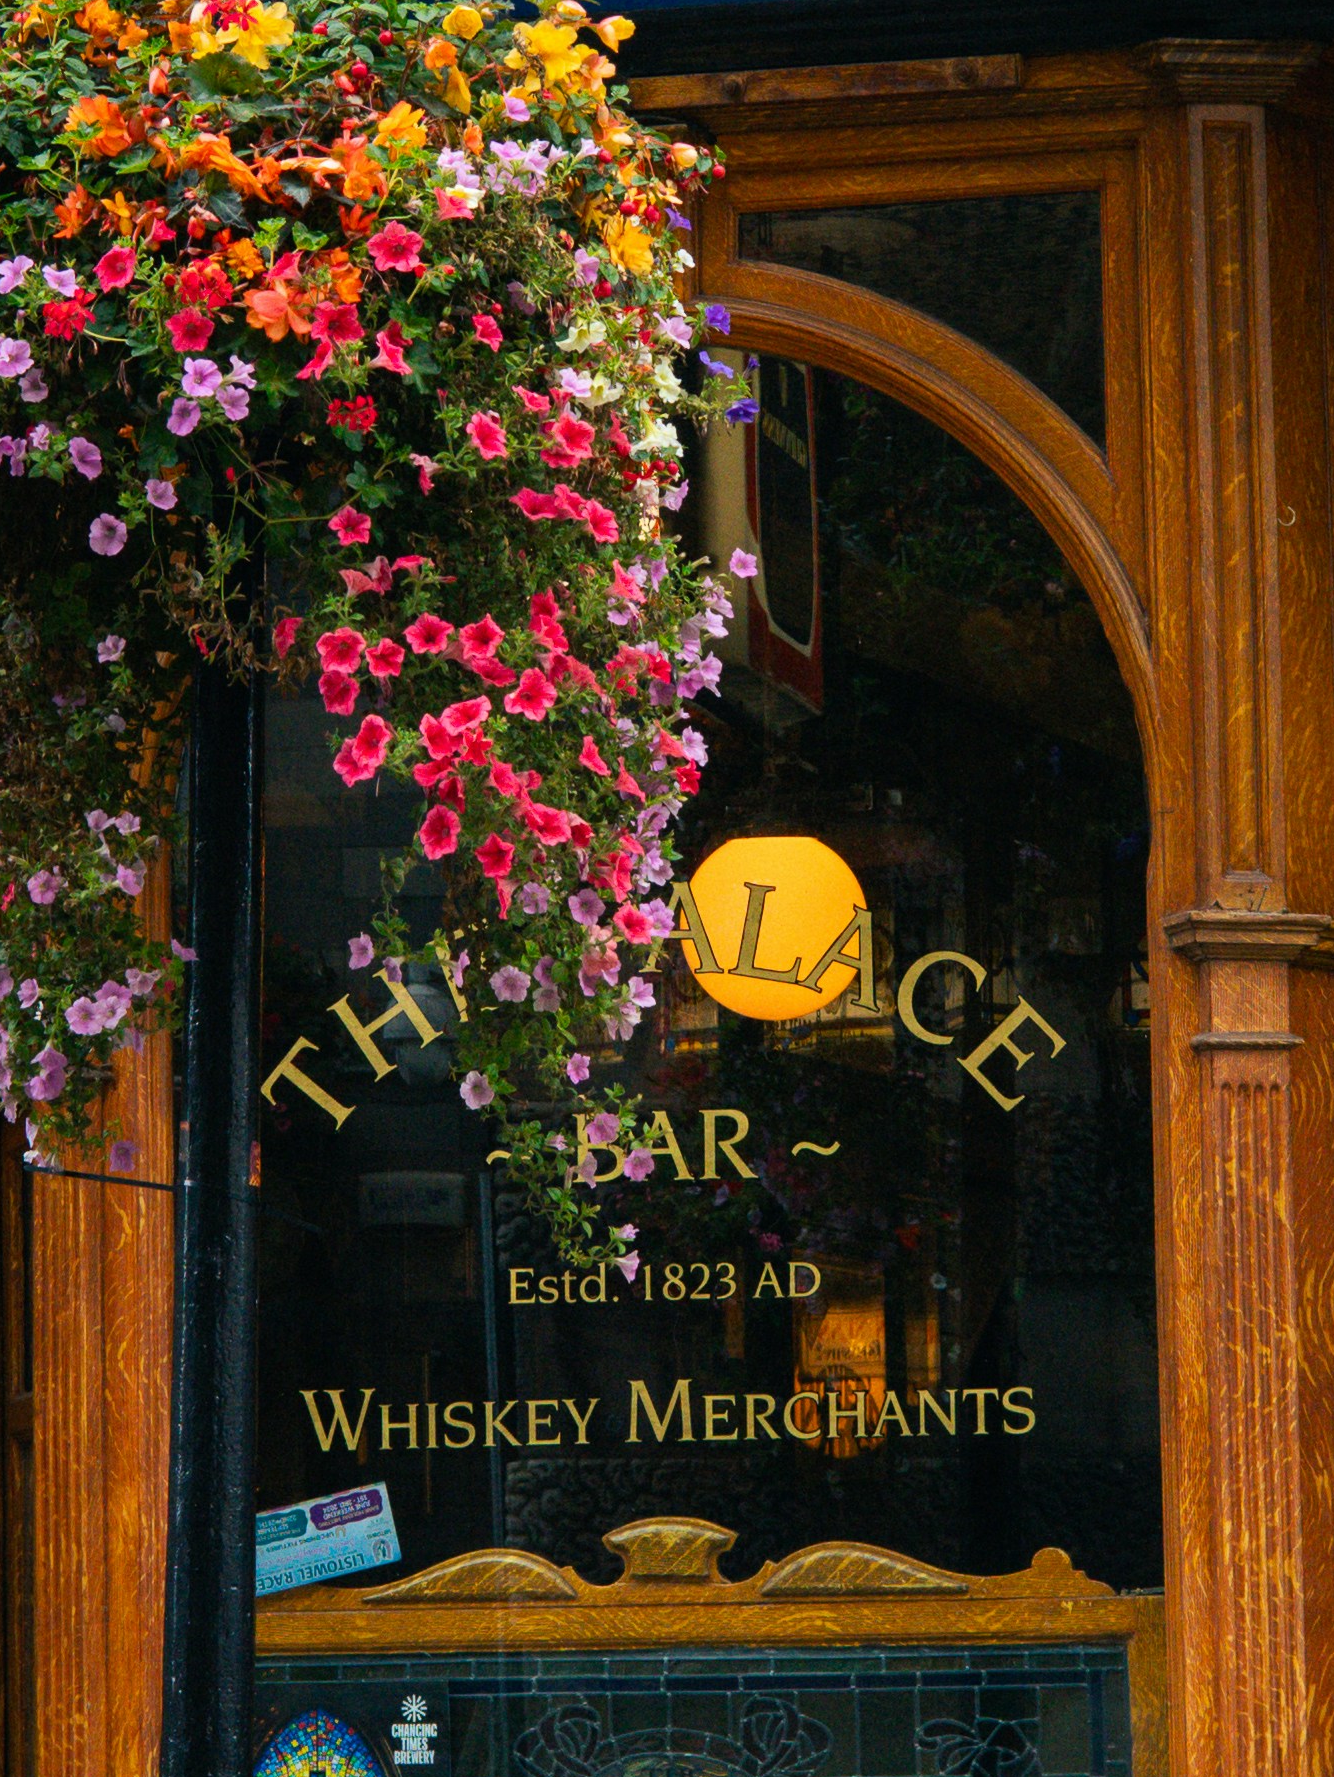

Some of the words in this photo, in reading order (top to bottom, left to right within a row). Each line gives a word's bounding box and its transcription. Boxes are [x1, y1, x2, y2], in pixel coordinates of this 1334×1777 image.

[633, 881, 1067, 1113] ALACE
[573, 1108, 759, 1184] BAR
[508, 1263, 621, 1304] Estd.
[641, 1262, 737, 1302] 1823
[754, 1261, 822, 1299] AD
[299, 1387, 599, 1452] WHISKEY
[626, 1378, 1036, 1445] MERCHANTS
[298, 1553, 365, 1581] LISTOWEL
[256, 1571, 293, 1592] RACE
[391, 1723, 438, 1737] CHANGING
[401, 1737, 428, 1751] TIMES
[394, 1749, 435, 1765] BREWERY
